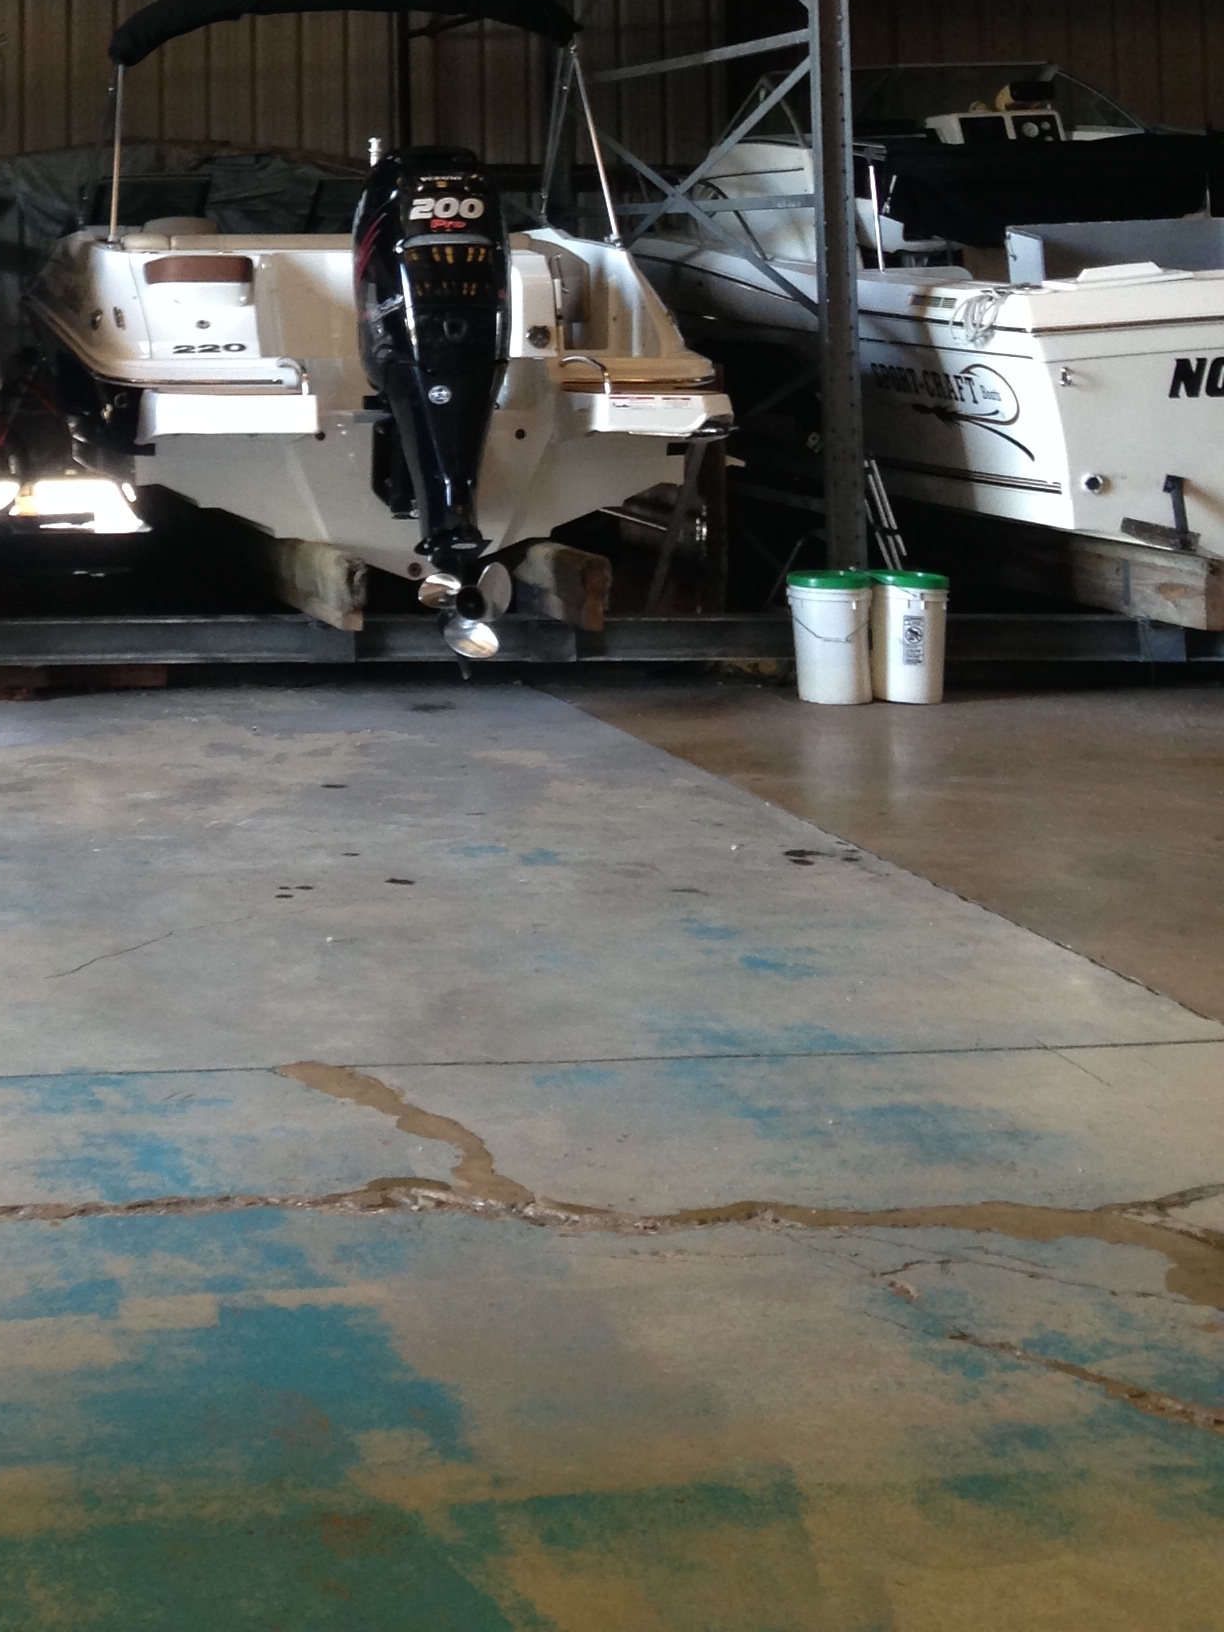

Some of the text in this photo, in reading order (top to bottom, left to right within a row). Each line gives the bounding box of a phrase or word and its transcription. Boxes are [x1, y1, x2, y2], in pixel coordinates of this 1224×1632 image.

[408, 196, 486, 221] 200
[429, 218, 467, 230] Pro
[172, 342, 247, 355] 220
